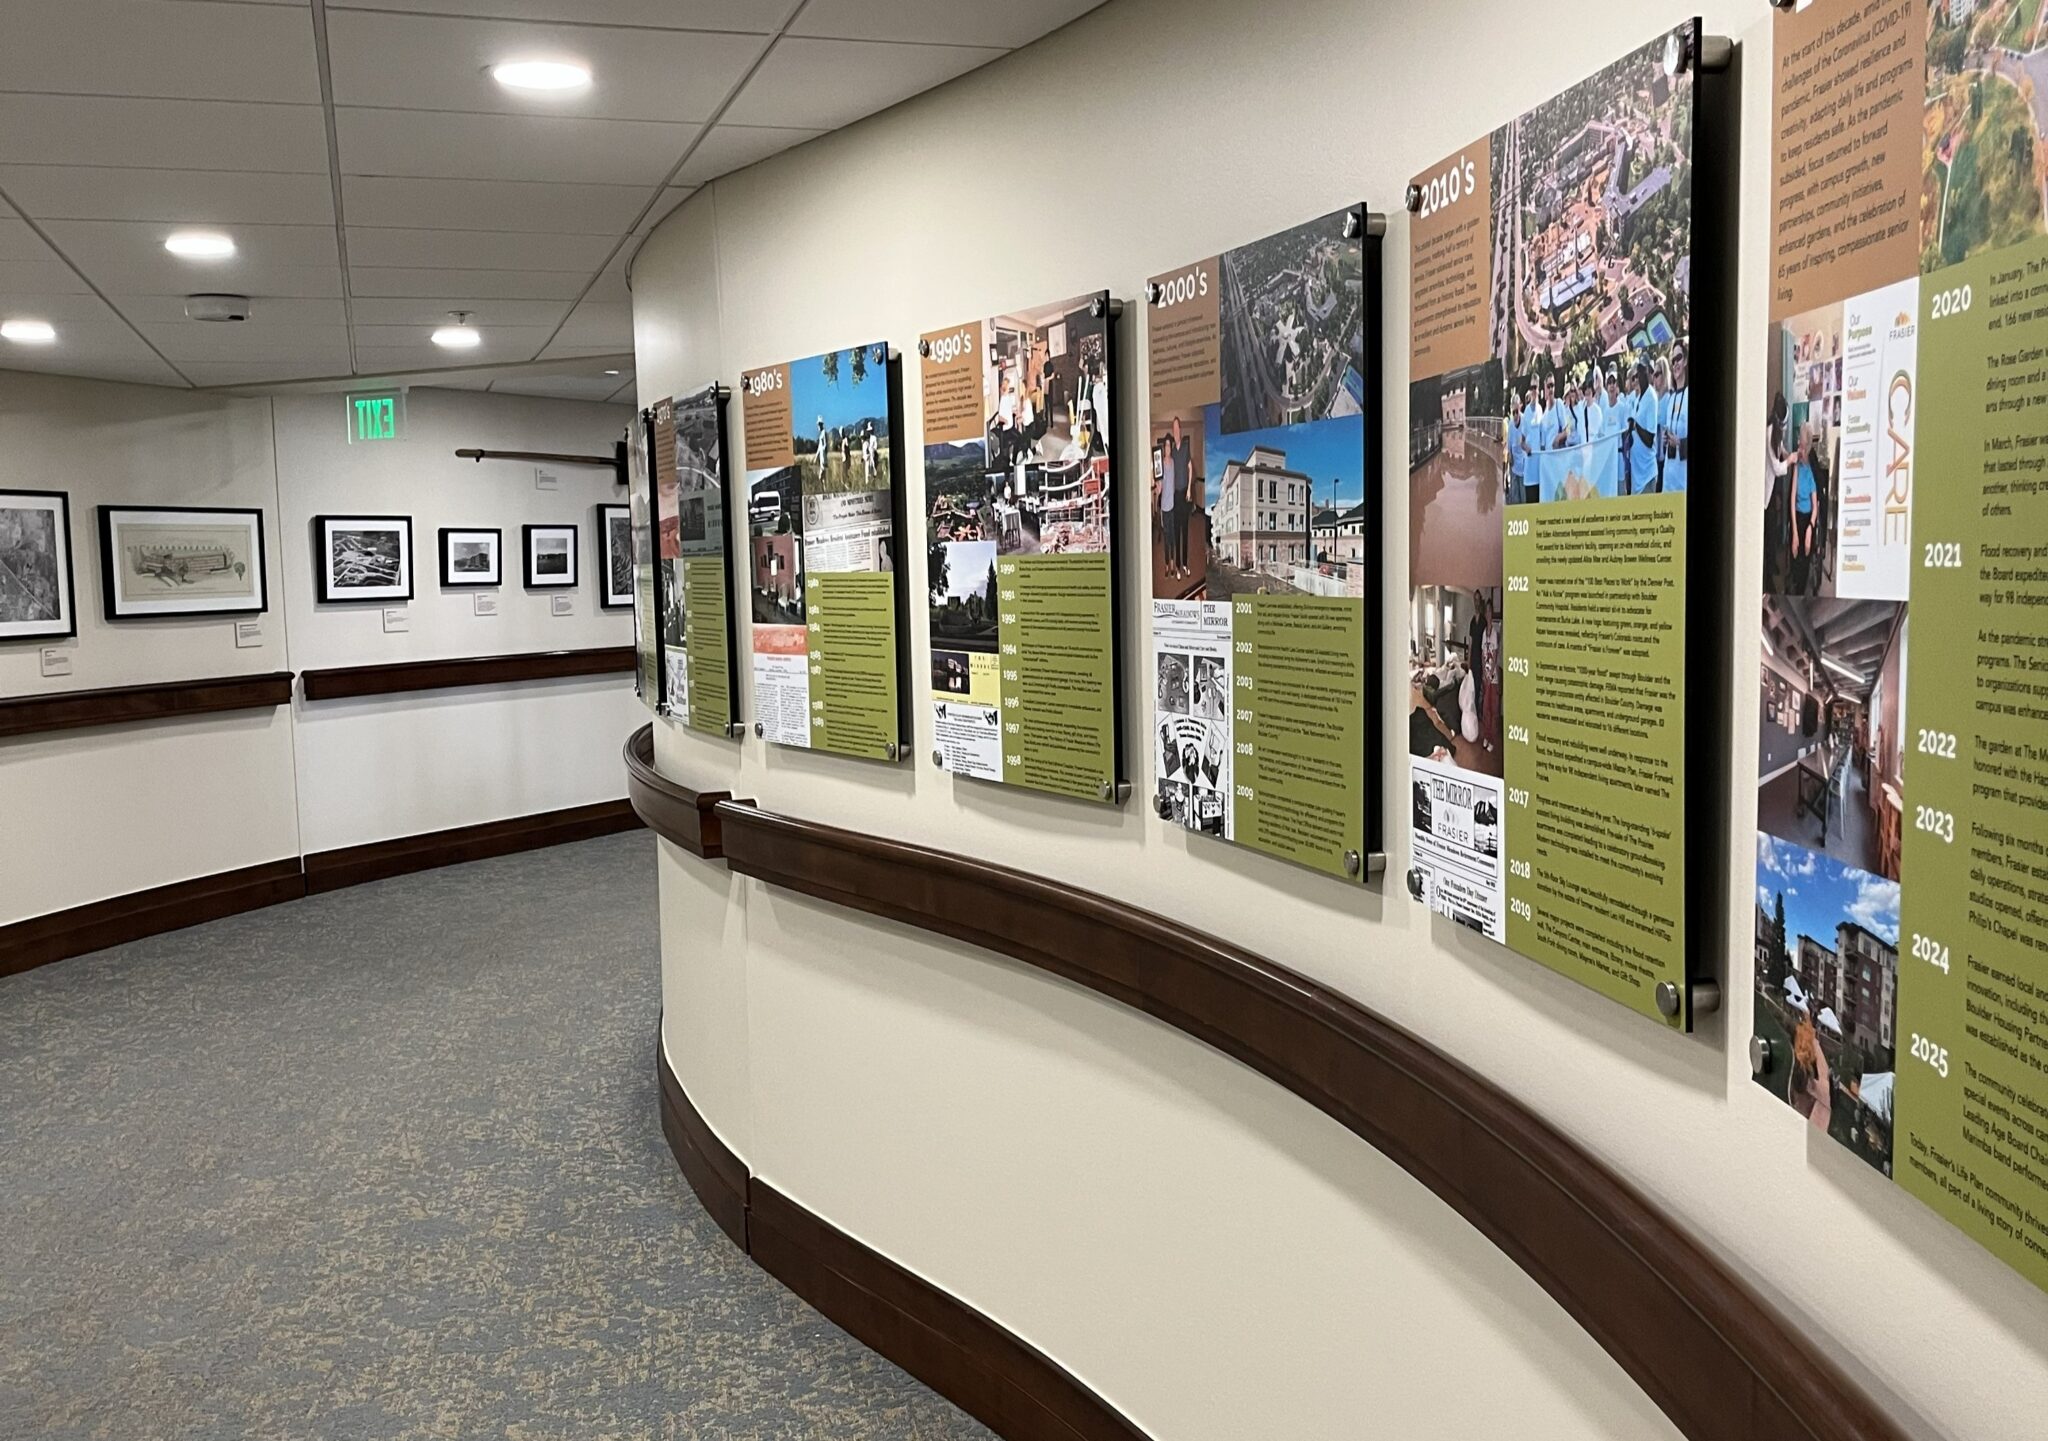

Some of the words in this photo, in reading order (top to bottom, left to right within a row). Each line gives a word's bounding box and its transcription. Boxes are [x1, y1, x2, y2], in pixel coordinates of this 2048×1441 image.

[1782, 56, 1789, 69] At
[1791, 51, 1800, 63] the
[1802, 40, 1815, 57] start
[1816, 32, 1823, 48] of
[1824, 27, 1835, 43] this
[1836, 12, 1861, 34] decade,
[1781, 67, 1812, 92] challenges
[1813, 56, 1820, 74] of
[1821, 55, 1831, 69] the
[1833, 31, 1870, 61] Coronavirus
[1813, 79, 1832, 96] Frasier
[1834, 59, 1858, 85] showed
[1860, 44, 1890, 69] resilience
[1892, 30, 1906, 51] and
[1810, 101, 1836, 123] adapting
[1837, 89, 1852, 108] daily
[1854, 82, 1863, 99] life
[1865, 73, 1878, 93] and
[1879, 58, 1912, 85] programs
[1808, 156, 1823, 171] focus
[1826, 141, 1851, 162] returned
[1853, 138, 1860, 150] to
[1862, 120, 1887, 144] forward
[1420, 155, 1475, 220] 2010's
[1990, 275, 1995, 285] In
[2026, 261, 2038, 273] The
[1158, 266, 1207, 308] 2000's
[1932, 284, 1971, 319] 2020
[1989, 292, 2008, 307] linked
[2010, 291, 2023, 302] into
[2024, 289, 2028, 298] a
[2018, 311, 2032, 321] new
[1889, 325, 1915, 341] FRASIER
[928, 329, 972, 364] 1990's
[1987, 356, 1998, 367] The
[2001, 354, 2016, 365] Rose
[2018, 348, 2042, 362] Garden
[749, 368, 783, 396] 1980's
[1986, 378, 2006, 391] dining
[2008, 375, 2025, 385] room
[2027, 368, 2040, 383] and
[1984, 440, 1989, 451] In
[2015, 435, 2037, 447] Frasier
[1884, 369, 1912, 546] CARE
[1983, 461, 1995, 473] that
[1998, 458, 2017, 471] lasted
[2019, 456, 2045, 471] through
[1508, 520, 1528, 535] 2010
[1925, 543, 1961, 567] 2021
[1980, 544, 2000, 557] Flood
[2002, 547, 2031, 560] recovery
[1001, 564, 1014, 574] 1990
[1980, 567, 1990, 579] the
[1992, 567, 2013, 580] Board
[1508, 576, 1528, 591] 2012
[1002, 591, 1015, 600] 1991
[1203, 604, 1216, 613] THE
[1236, 603, 1252, 613] 2001
[1203, 617, 1228, 626] MIRROR
[1236, 642, 1252, 653] 2002
[1978, 629, 1986, 641] As
[1988, 630, 1999, 643] the
[2001, 635, 2035, 646] pandemic
[1003, 644, 1016, 654] 1994
[1508, 657, 1528, 676] 2013
[2013, 655, 2026, 669] The
[1237, 676, 1252, 689] 2003
[1237, 709, 1252, 723] 2007
[1006, 723, 1019, 733] 1997
[1509, 725, 1528, 744] 2014
[1237, 743, 1253, 755] 2008
[1919, 729, 1955, 758] 2022
[1007, 755, 1021, 766] 1998
[1237, 785, 1253, 800] 2009
[1432, 778, 1444, 801] THE
[1446, 781, 1473, 810] MIRROR
[1509, 788, 1529, 808] 2017
[1437, 822, 1469, 843] FRASIER
[1916, 806, 1953, 843] 2023
[1510, 859, 1530, 878] 2018
[1511, 898, 1531, 921] 2019
[1912, 934, 1949, 974] 2024
[1966, 999, 1991, 1020] Boulder
[1994, 1013, 2022, 1040] Housing
[1911, 1033, 1948, 1077] 2025
[1964, 1061, 1976, 1078] The
[1978, 1073, 2015, 1103] community
[1964, 1087, 1986, 1106] special
[1987, 1101, 2009, 1120] events
[2012, 1114, 2033, 1134] across
[1963, 1105, 1989, 1134] Leading
[1991, 1122, 2005, 1141] Age
[2007, 1131, 2028, 1155] Board
[1962, 1126, 1991, 1155] Marimba
[1993, 1145, 2011, 1167] band
[1930, 1146, 1955, 1173] Frasier's
[1957, 1164, 1968, 1181] Life
[1969, 1172, 1984, 1190] Plan
[1985, 1187, 2023, 1221] community
[1948, 1183, 1962, 1199] part
[1963, 1191, 1970, 1204] of
[1971, 1199, 1976, 1208] a
[1977, 1199, 1995, 1226] living
[1996, 1215, 2013, 1238] story
[2015, 1228, 2023, 1241] of
